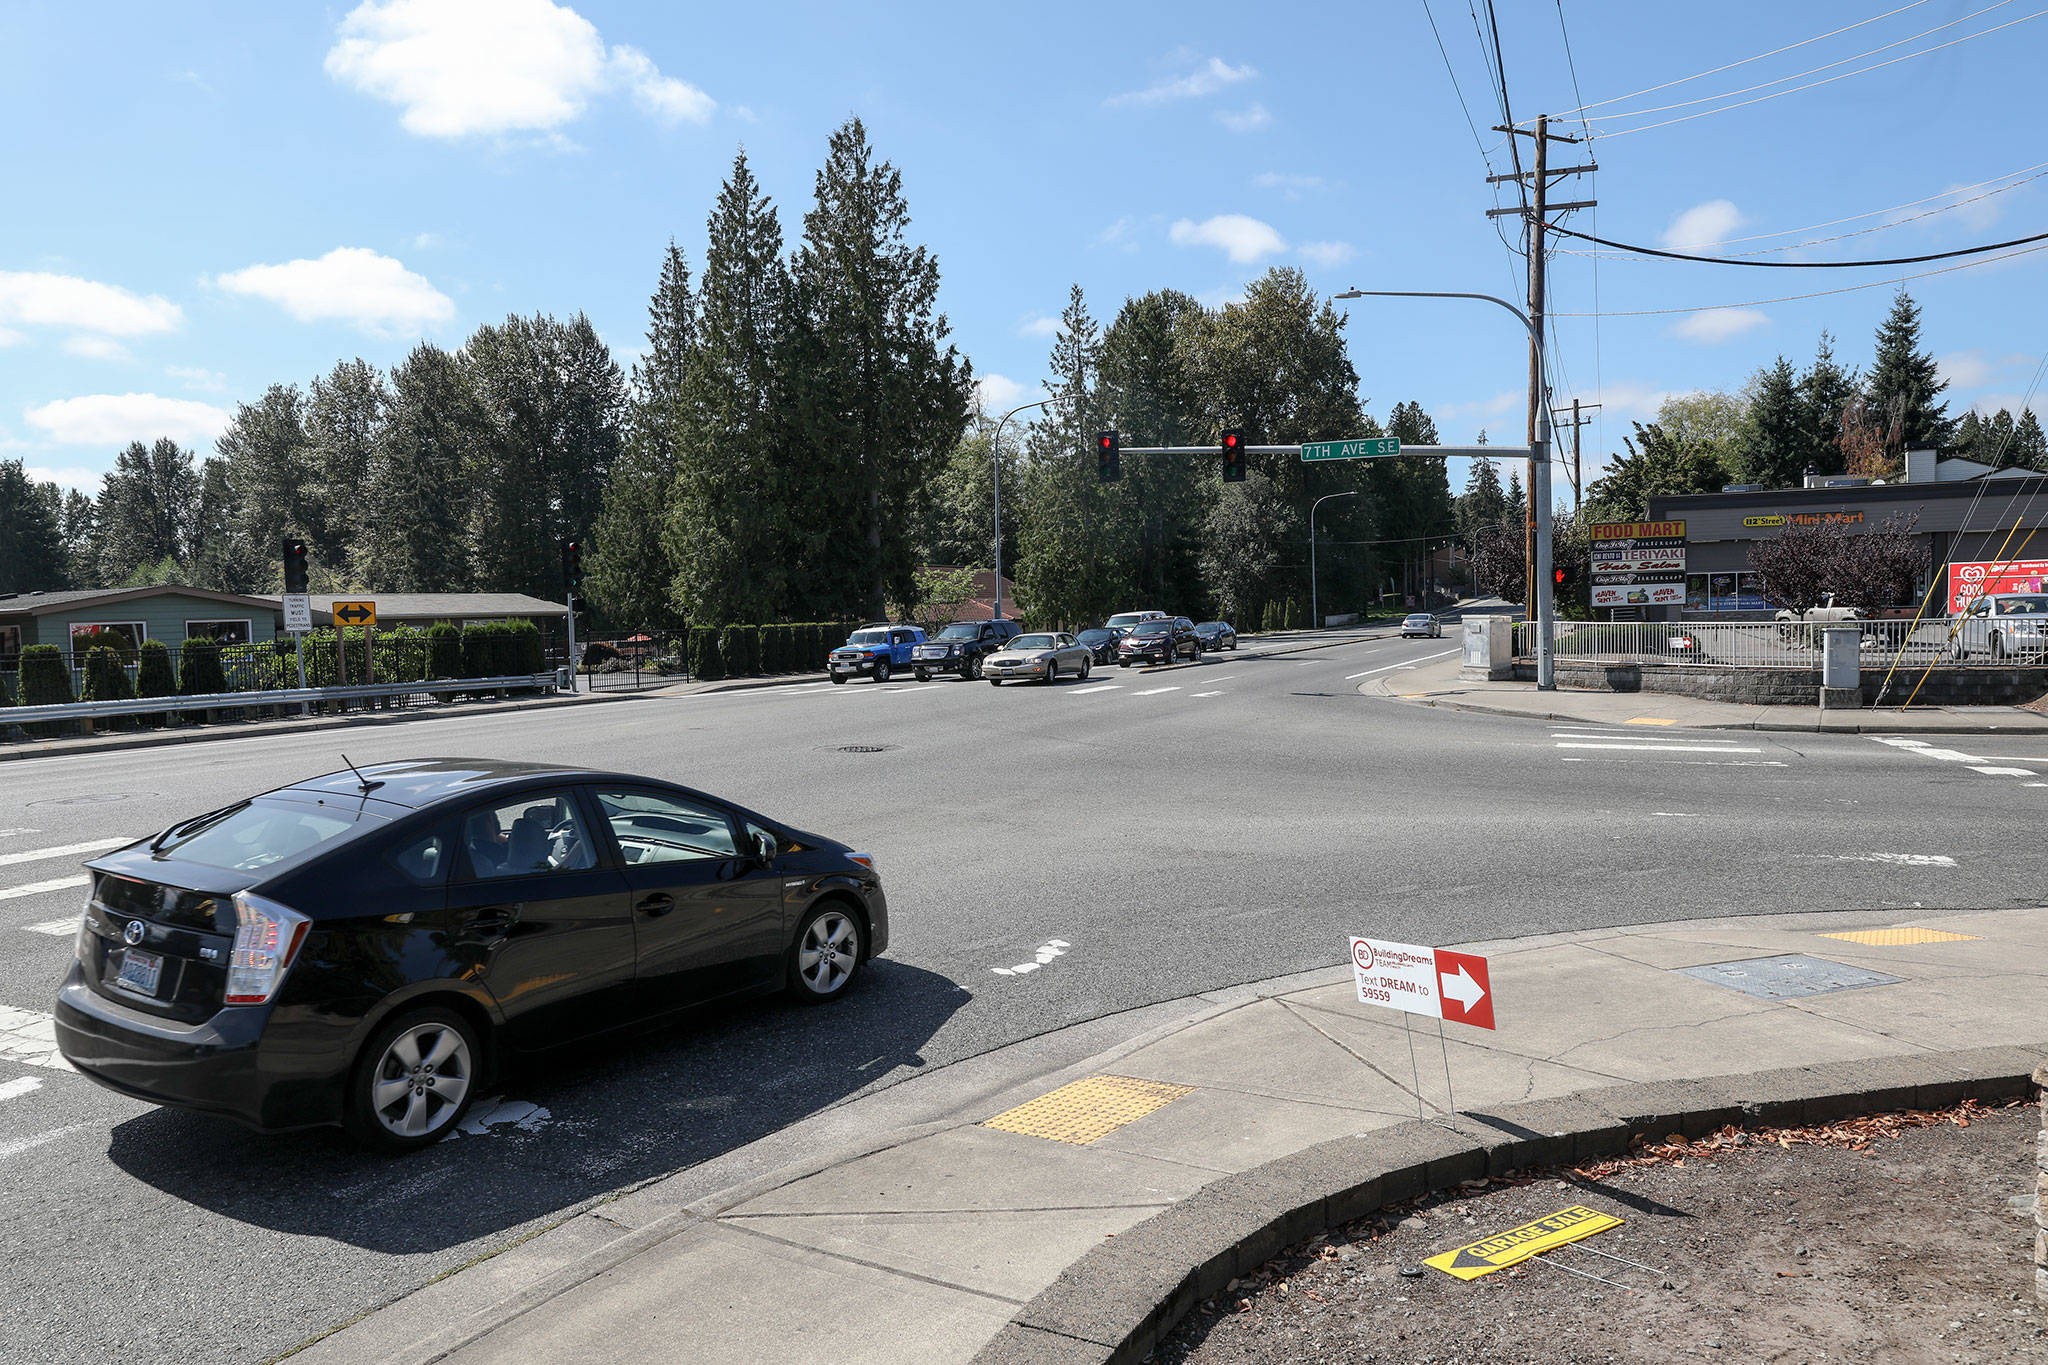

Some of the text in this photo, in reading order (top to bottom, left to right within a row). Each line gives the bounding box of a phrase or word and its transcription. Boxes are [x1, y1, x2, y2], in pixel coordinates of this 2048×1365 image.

[1304, 446, 1330, 458] 7TH
[1341, 443, 1368, 456] AVE.
[1594, 522, 1682, 539] FOOD MART
[1623, 549, 1684, 560] TERIYAKI
[1596, 561, 1681, 571] Hair Salon
[1960, 584, 1984, 595] GOOD
[1373, 948, 1433, 966] BuildingDreams
[1360, 973, 1429, 996] Text DREAM to
[1362, 987, 1391, 1002] 59559
[1467, 1209, 1598, 1258] GARAGE SALE
